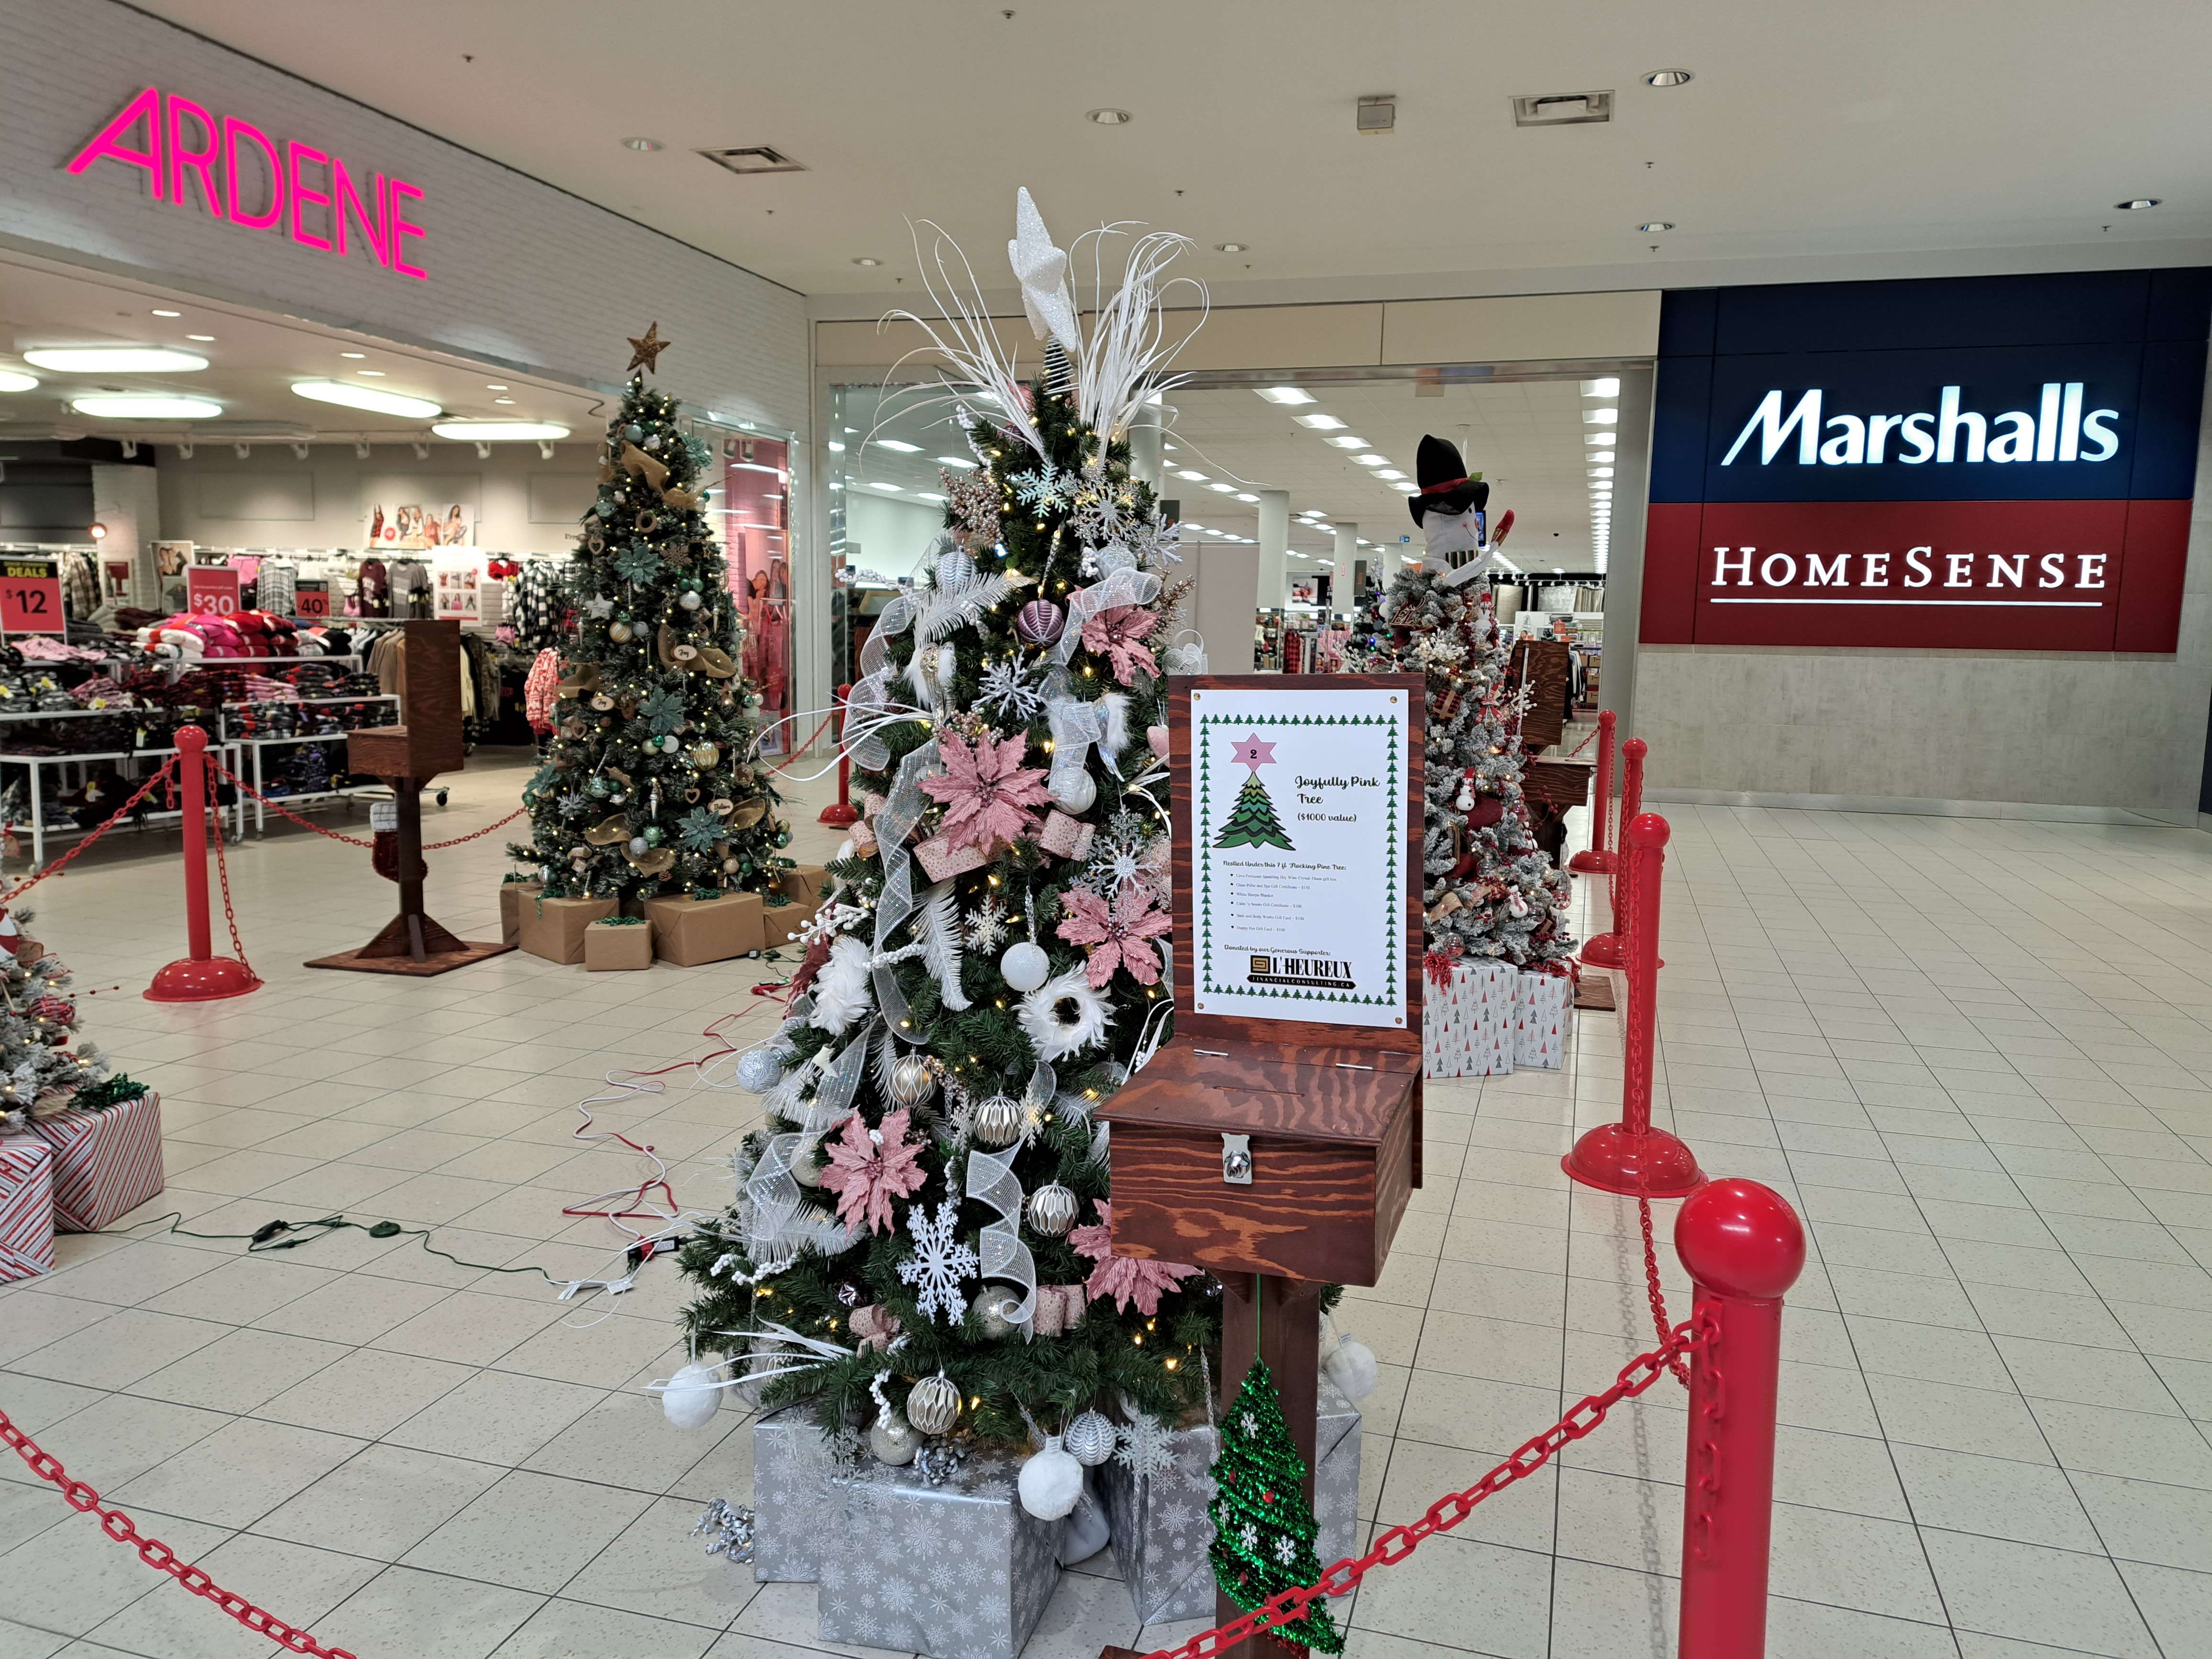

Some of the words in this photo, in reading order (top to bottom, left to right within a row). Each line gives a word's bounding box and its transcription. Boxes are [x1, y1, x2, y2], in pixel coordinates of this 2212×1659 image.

[65, 86, 428, 280] ARDENE
[1721, 382, 2119, 466] Marshalls
[7, 566, 48, 578] DEALS
[6, 589, 48, 613] $12
[194, 593, 234, 615] $30
[678, 649, 689, 658] Joy
[1250, 749, 1257, 759] 2
[1295, 775, 1349, 790] Joyfully
[1351, 776, 1381, 787] Pink
[1297, 793, 1324, 804] Tree
[1298, 812, 1326, 821] ($1000
[1328, 813, 1357, 822] value)
[1272, 956, 1352, 979] L'HEUREUX
